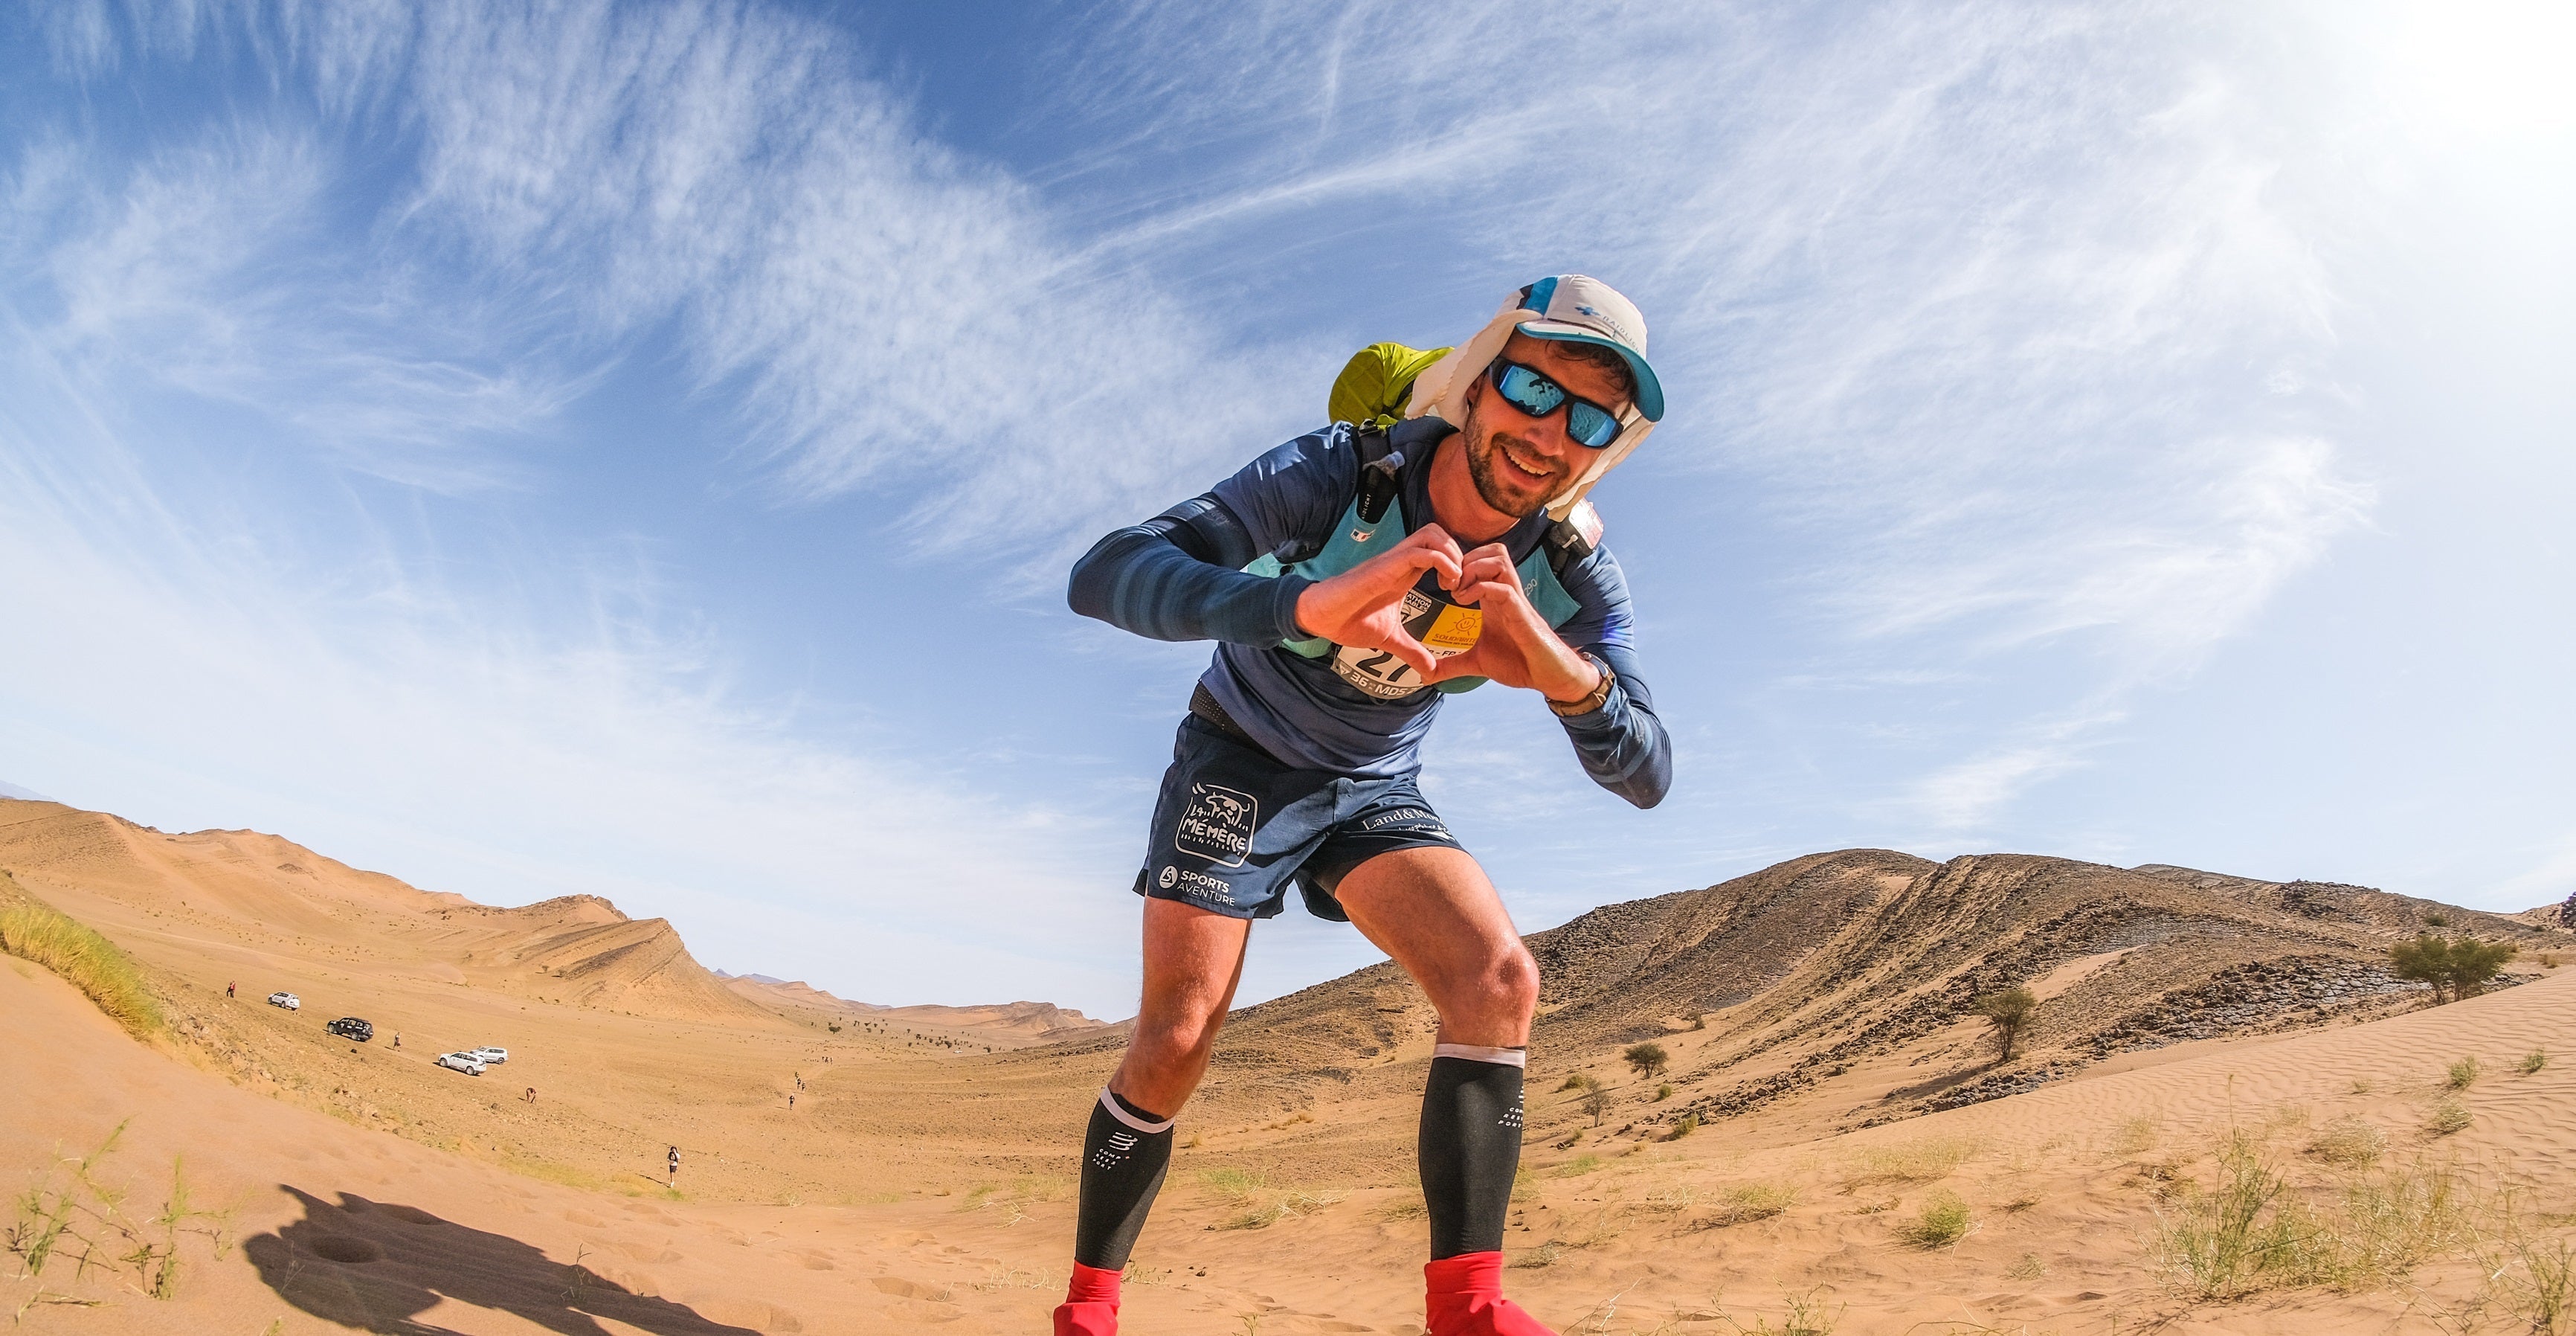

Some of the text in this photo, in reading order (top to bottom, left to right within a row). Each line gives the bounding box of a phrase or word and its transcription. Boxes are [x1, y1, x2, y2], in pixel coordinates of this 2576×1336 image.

[1603, 315, 1639, 353] RAIDLIGH
[1361, 493, 1371, 519] AIDLIGHT
[1350, 671, 1368, 687] 36
[1181, 870, 1230, 893] SPORTS
[1176, 882, 1235, 907] AVENTURE
